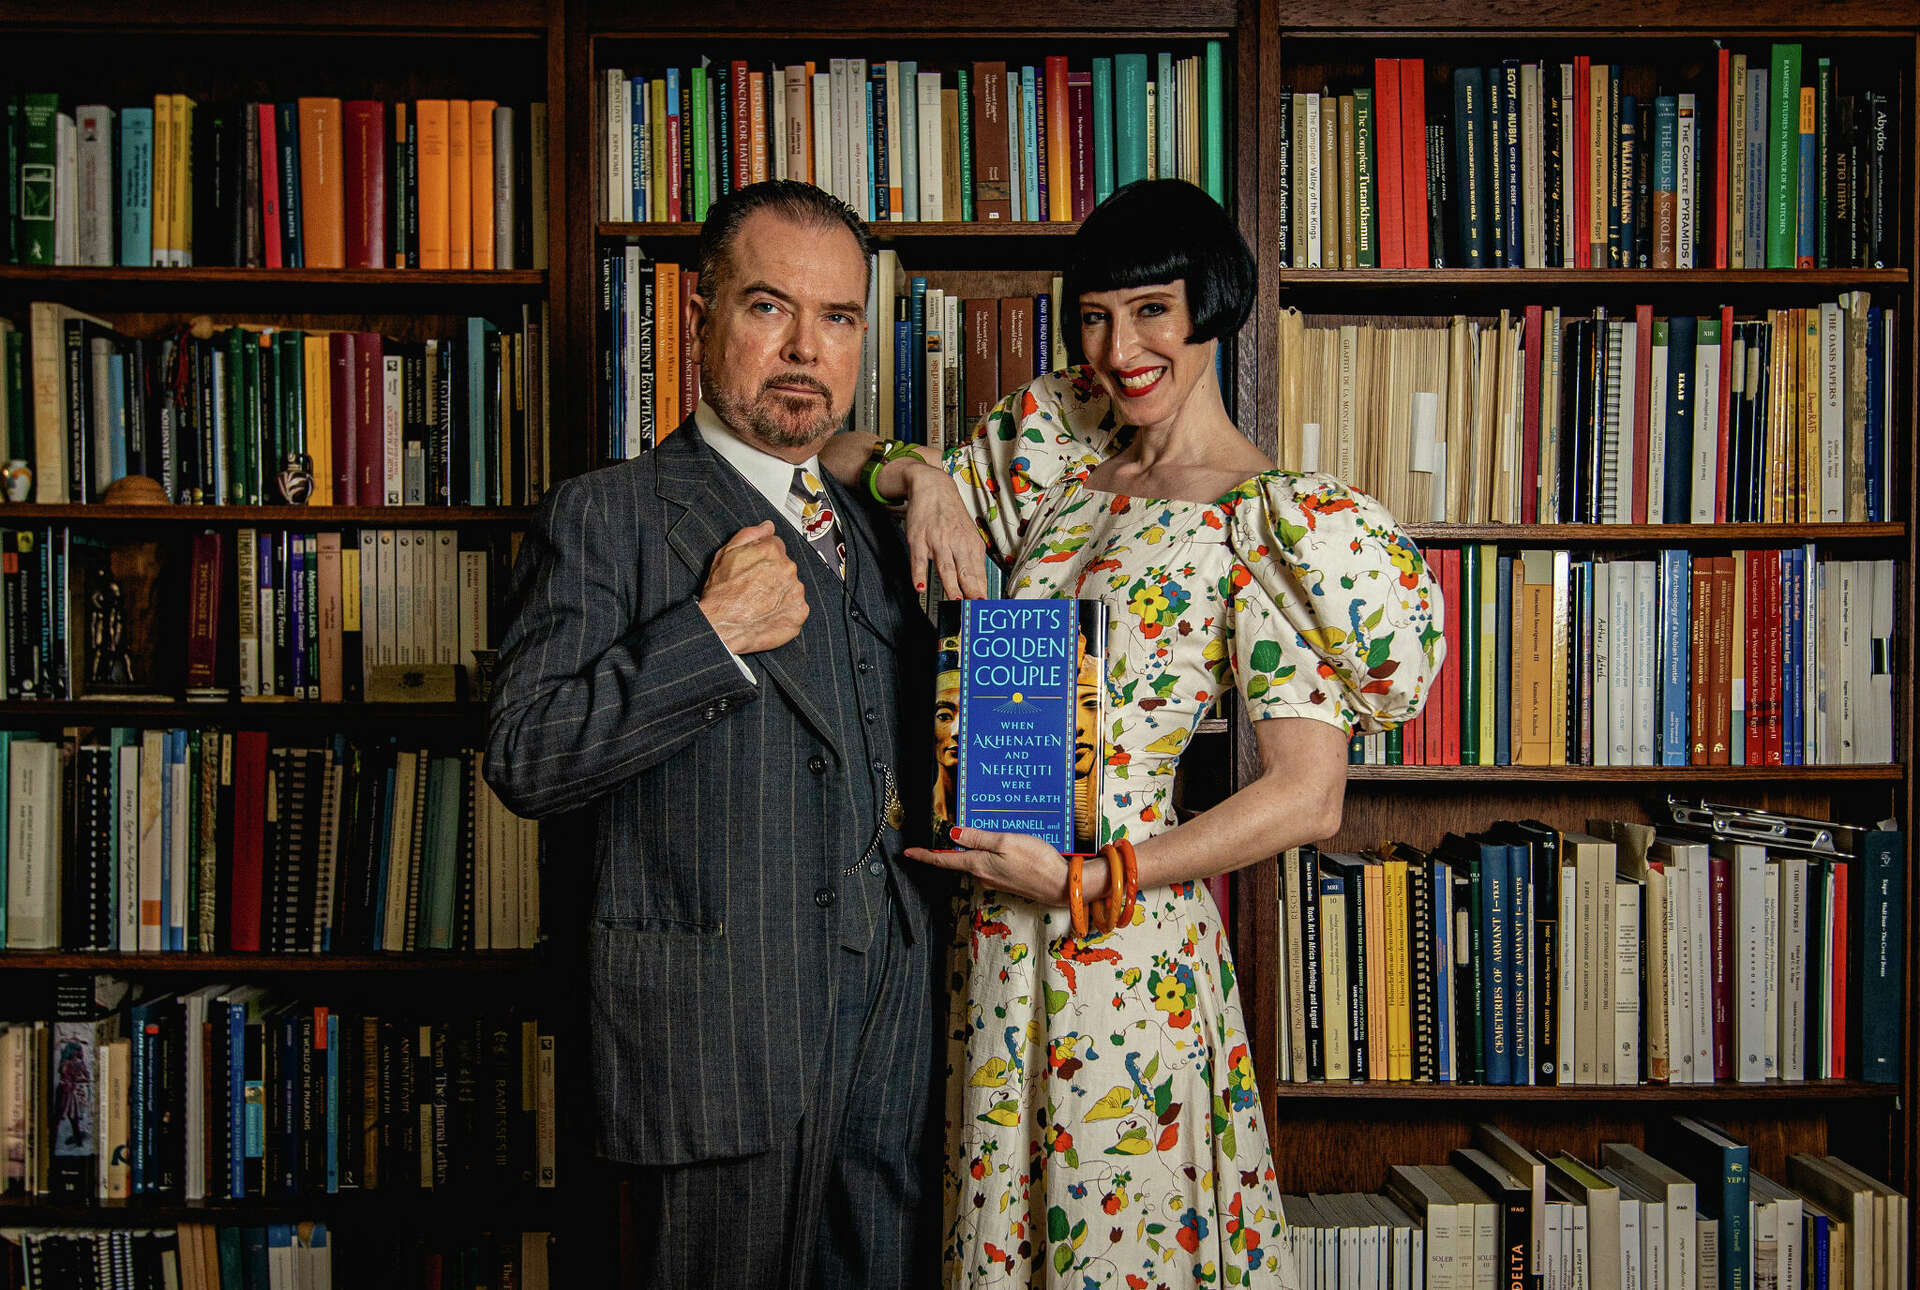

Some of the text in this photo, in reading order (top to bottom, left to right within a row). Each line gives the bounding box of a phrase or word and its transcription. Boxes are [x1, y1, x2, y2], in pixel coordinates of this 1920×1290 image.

[1829, 312, 1837, 331] THE
[1829, 334, 1837, 362] OASIS
[1829, 364, 1837, 399] PAPERS
[1808, 392, 1817, 434] Desert RATS
[979, 609, 1060, 633] EGYPT'S
[973, 638, 1065, 662] GOLDEN
[975, 666, 1061, 686] COUPLE
[973, 734, 1062, 748] AKHENATEN
[980, 762, 1052, 777] NEFERTITI
[971, 794, 1002, 802] GODS
[1025, 795, 1060, 803] EARTH
[970, 819, 997, 828] JOHN
[1002, 820, 1044, 830] DARNELL
[1032, 833, 1062, 844] NELL
[1511, 1244, 1524, 1290] DELTA
